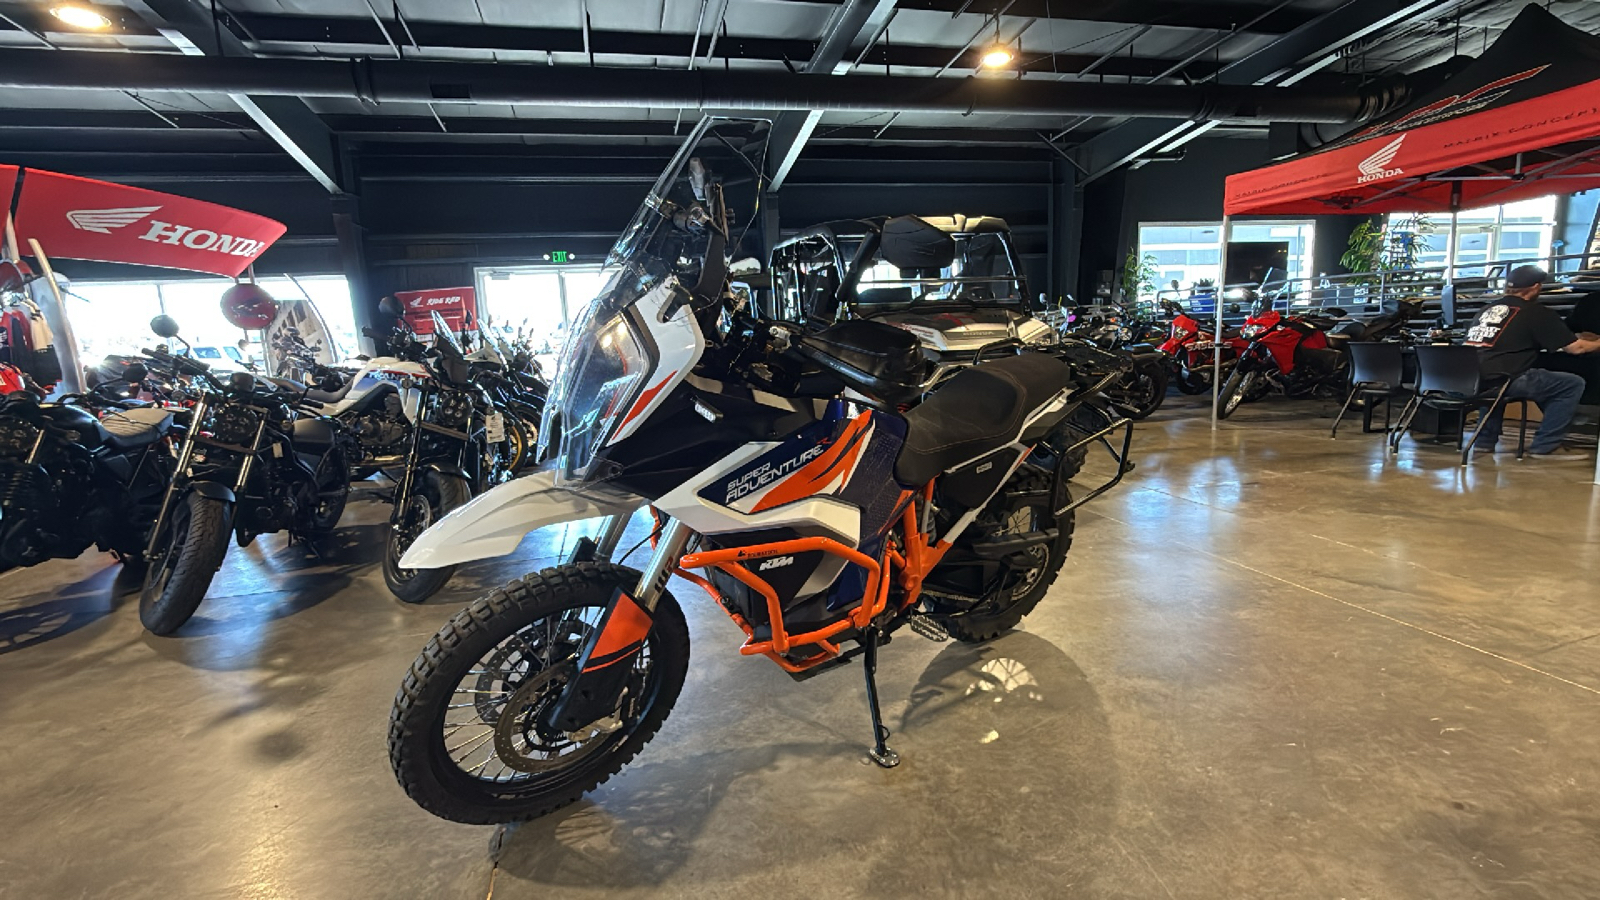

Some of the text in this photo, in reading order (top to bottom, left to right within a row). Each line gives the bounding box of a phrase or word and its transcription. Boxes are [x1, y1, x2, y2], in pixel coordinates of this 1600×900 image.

[1357, 168, 1404, 184] HONDA
[138, 220, 265, 258] HONDA
[552, 251, 567, 263] EXIT
[1184, 341, 1233, 352] GASGS
[725, 445, 824, 503] ADVENTURE
[726, 462, 771, 492] SUPER
[759, 556, 794, 571] KTM
